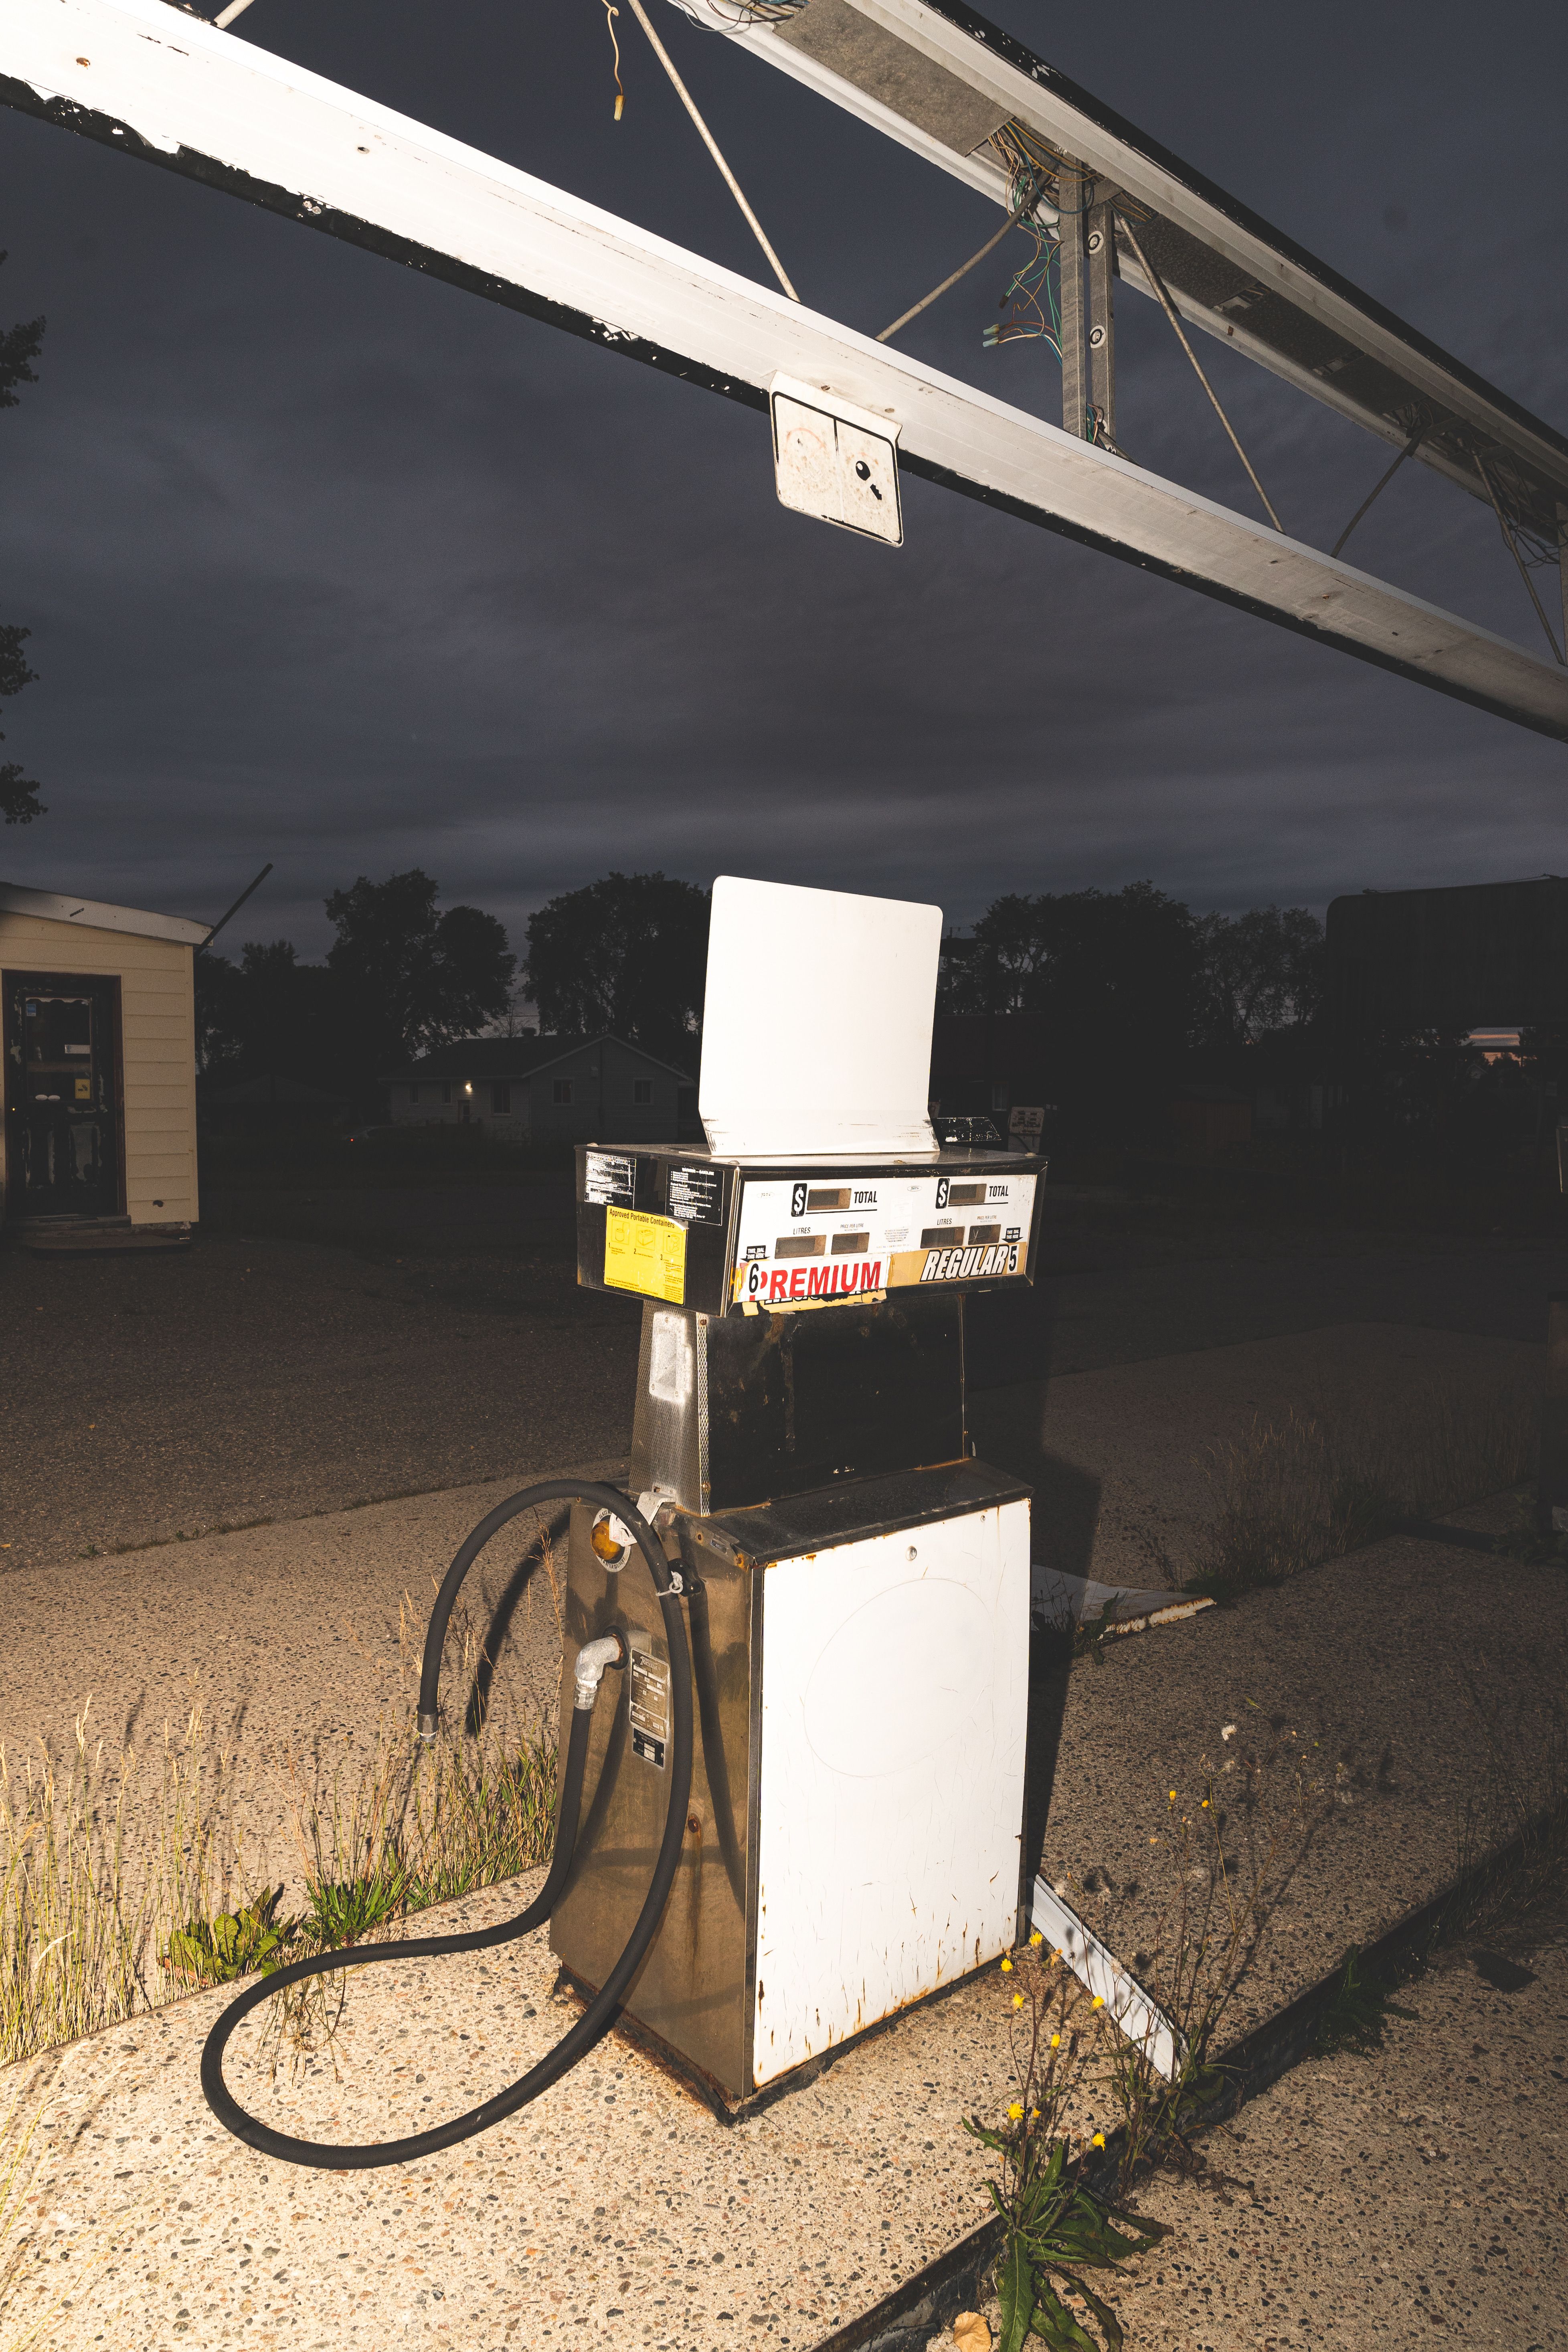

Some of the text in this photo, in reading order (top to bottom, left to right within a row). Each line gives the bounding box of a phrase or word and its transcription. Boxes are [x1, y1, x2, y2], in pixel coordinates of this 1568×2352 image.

[854, 1191, 877, 1203] TOTAL
[989, 1186, 1009, 1197] TOTAL
[609, 1208, 675, 1228] Approved Portable Containers
[919, 1245, 1017, 1282] REGULAR 5
[749, 1263, 759, 1293] 6
[599, 1510, 607, 1519] GLASS
[614, 1556, 625, 1569] DELIVERY
